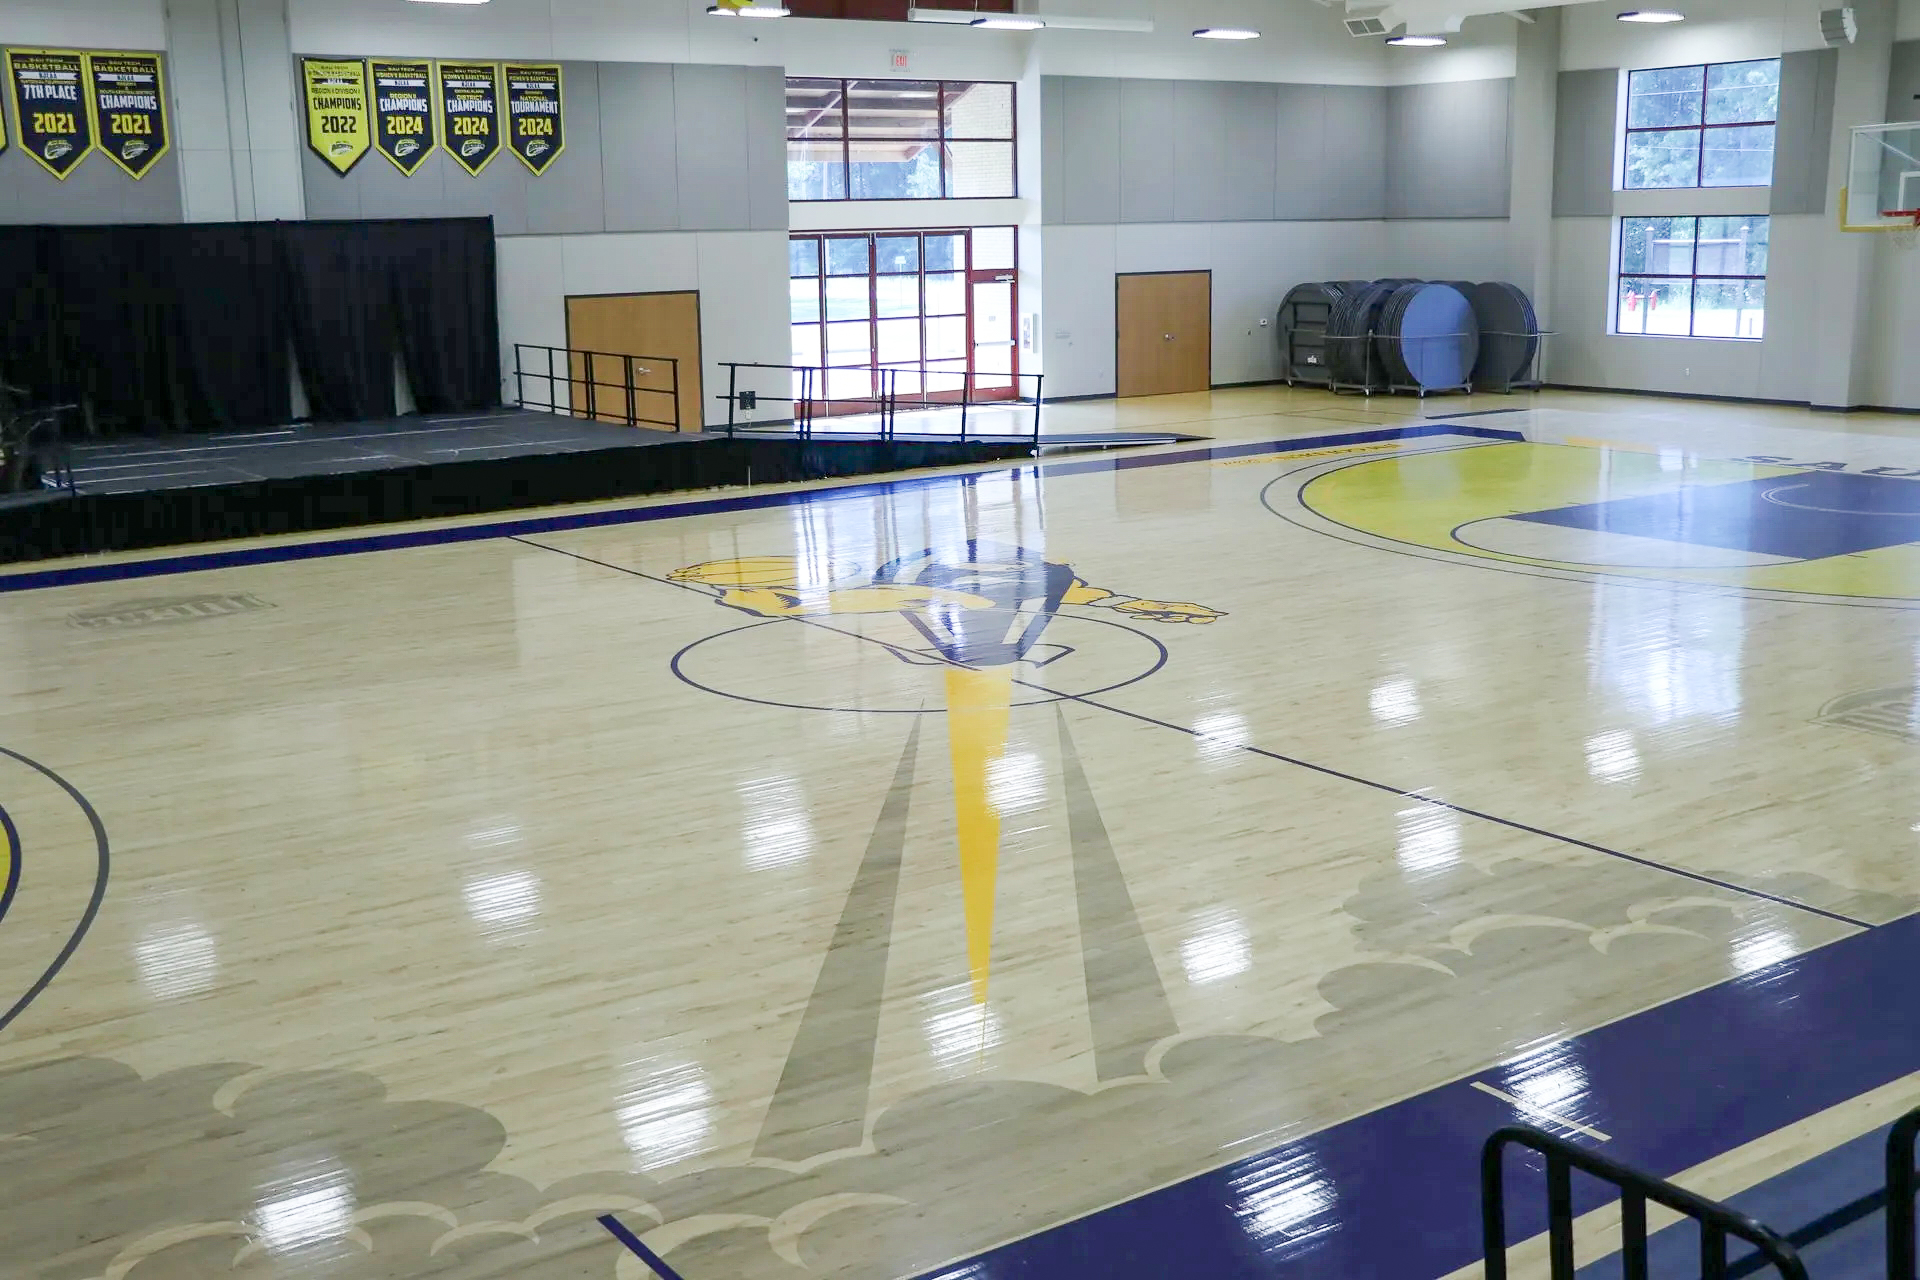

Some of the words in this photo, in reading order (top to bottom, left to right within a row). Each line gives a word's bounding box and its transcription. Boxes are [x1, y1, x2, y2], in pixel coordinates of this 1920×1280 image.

[14, 63, 80, 71] BASKETBALL
[94, 65, 155, 73] BASKETBALL
[24, 85, 45, 100] 7TH
[46, 85, 78, 100] PLACE
[101, 95, 157, 110] CHAMPIONS
[313, 97, 362, 111] CHAMPIONS
[380, 98, 428, 113] CHAMPIONS
[447, 99, 494, 114] CHAMPIONS
[511, 100, 558, 114] TOURNAMENT
[33, 112, 77, 134] 2021
[110, 113, 152, 134] 2021
[321, 115, 357, 134] 2022
[386, 115, 424, 135] 2024
[453, 116, 489, 136] 2024
[518, 117, 553, 136] 2024
